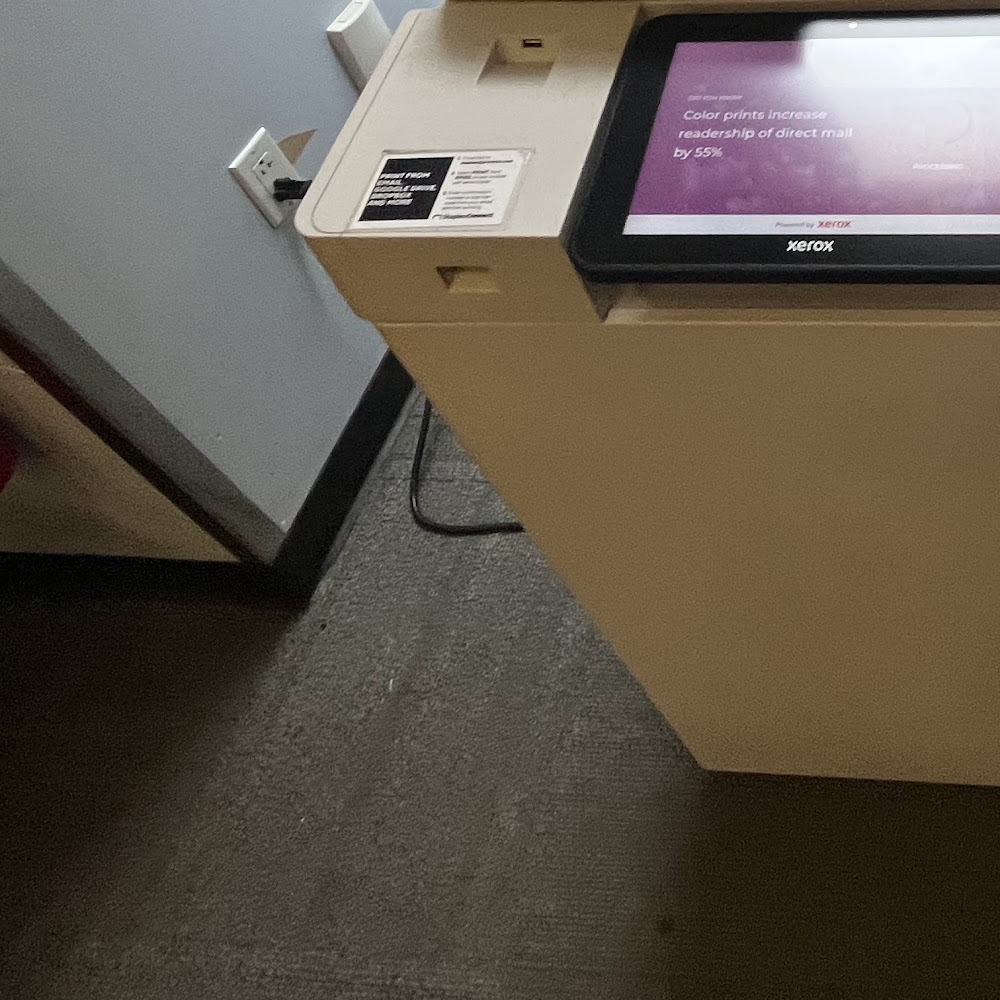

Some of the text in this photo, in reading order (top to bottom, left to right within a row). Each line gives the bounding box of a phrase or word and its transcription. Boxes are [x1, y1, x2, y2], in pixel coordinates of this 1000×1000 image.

[683, 109, 828, 122] Color prints increase
[678, 127, 853, 140] readership of direct mail
[673, 146, 723, 160] by 55%
[817, 219, 852, 229] xerox
[786, 239, 835, 252] xerox
